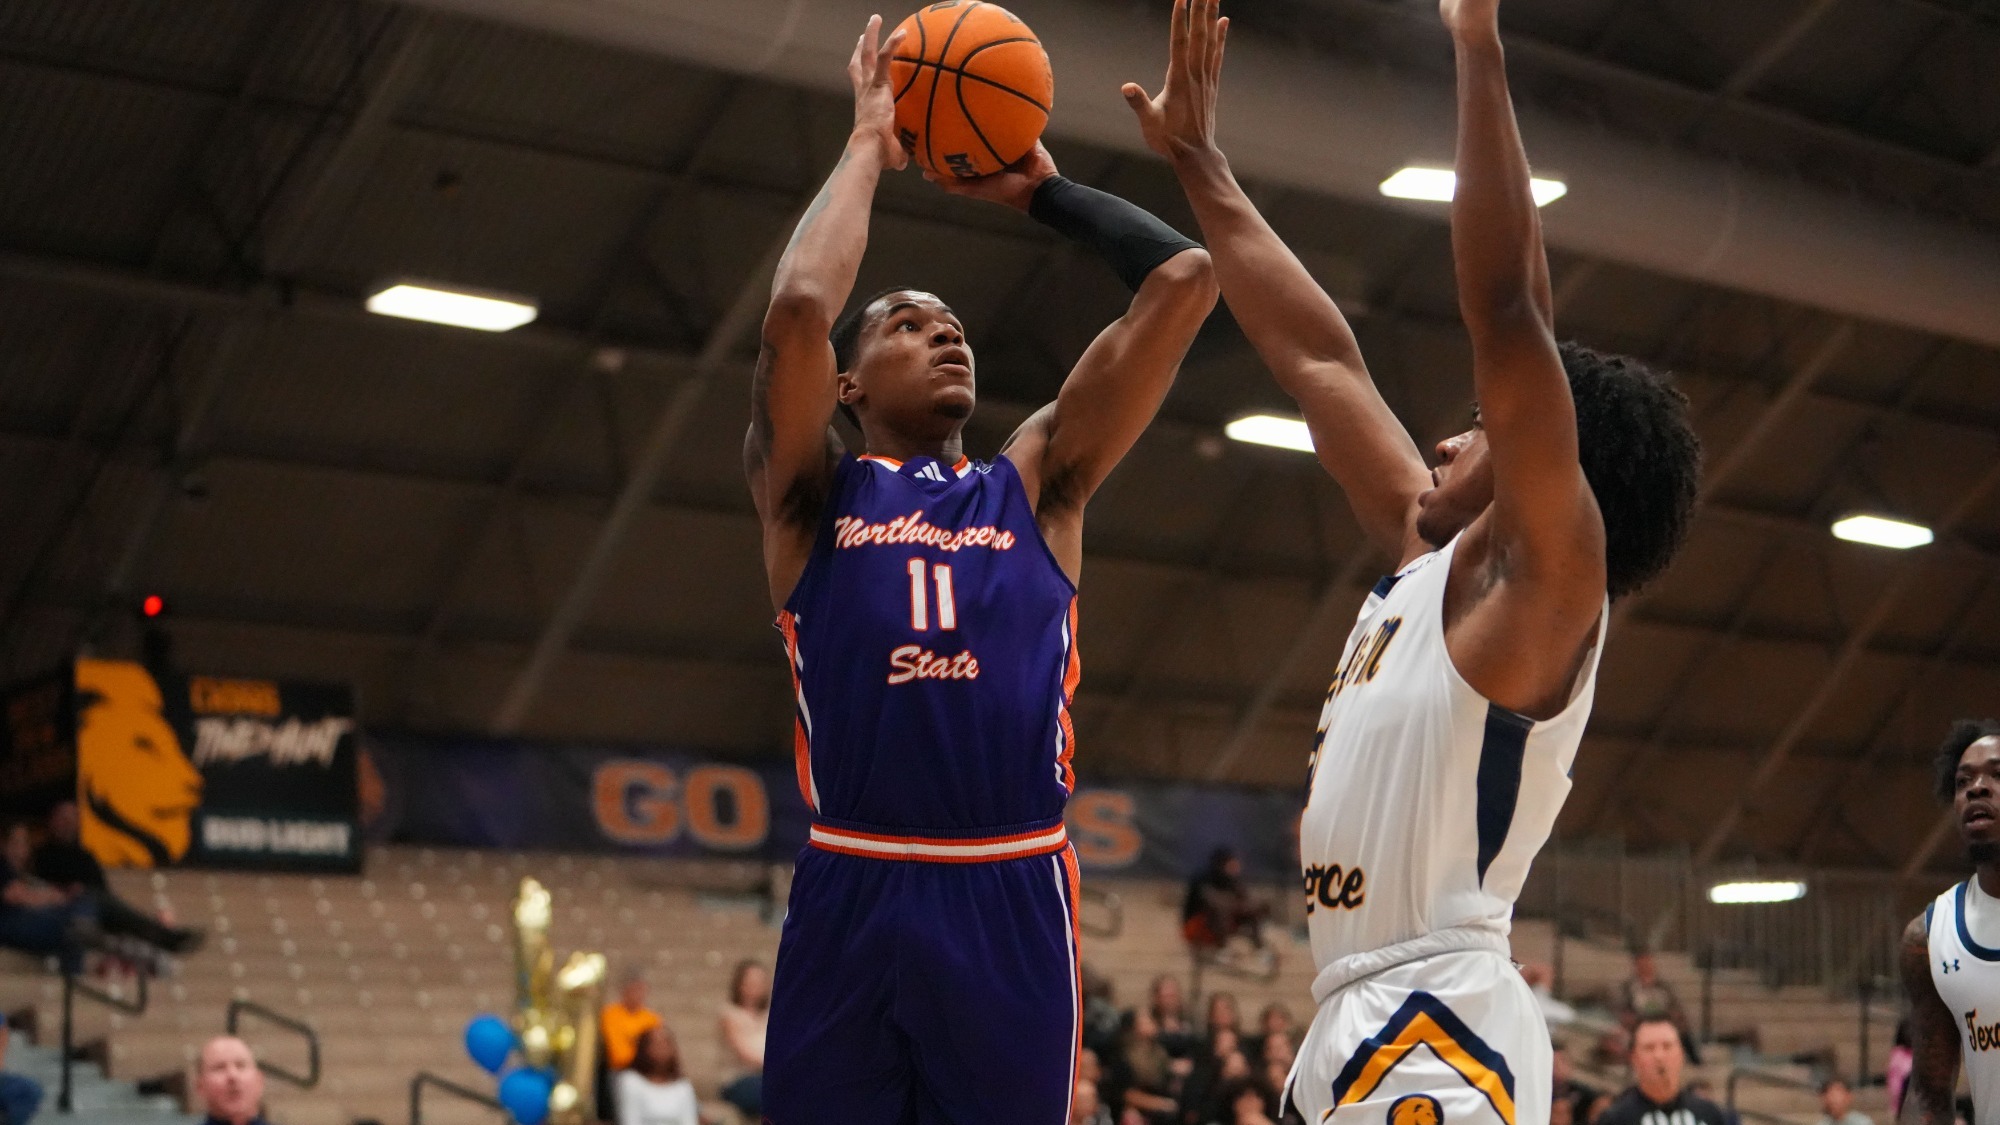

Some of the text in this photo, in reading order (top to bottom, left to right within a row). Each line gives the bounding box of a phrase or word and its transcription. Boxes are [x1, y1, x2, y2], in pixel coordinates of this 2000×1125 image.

[835, 510, 1016, 551] Northwestern
[907, 557, 956, 631] 11
[888, 644, 979, 685] State
[593, 759, 769, 851] GO
[268, 817, 351, 857] LIGHT
